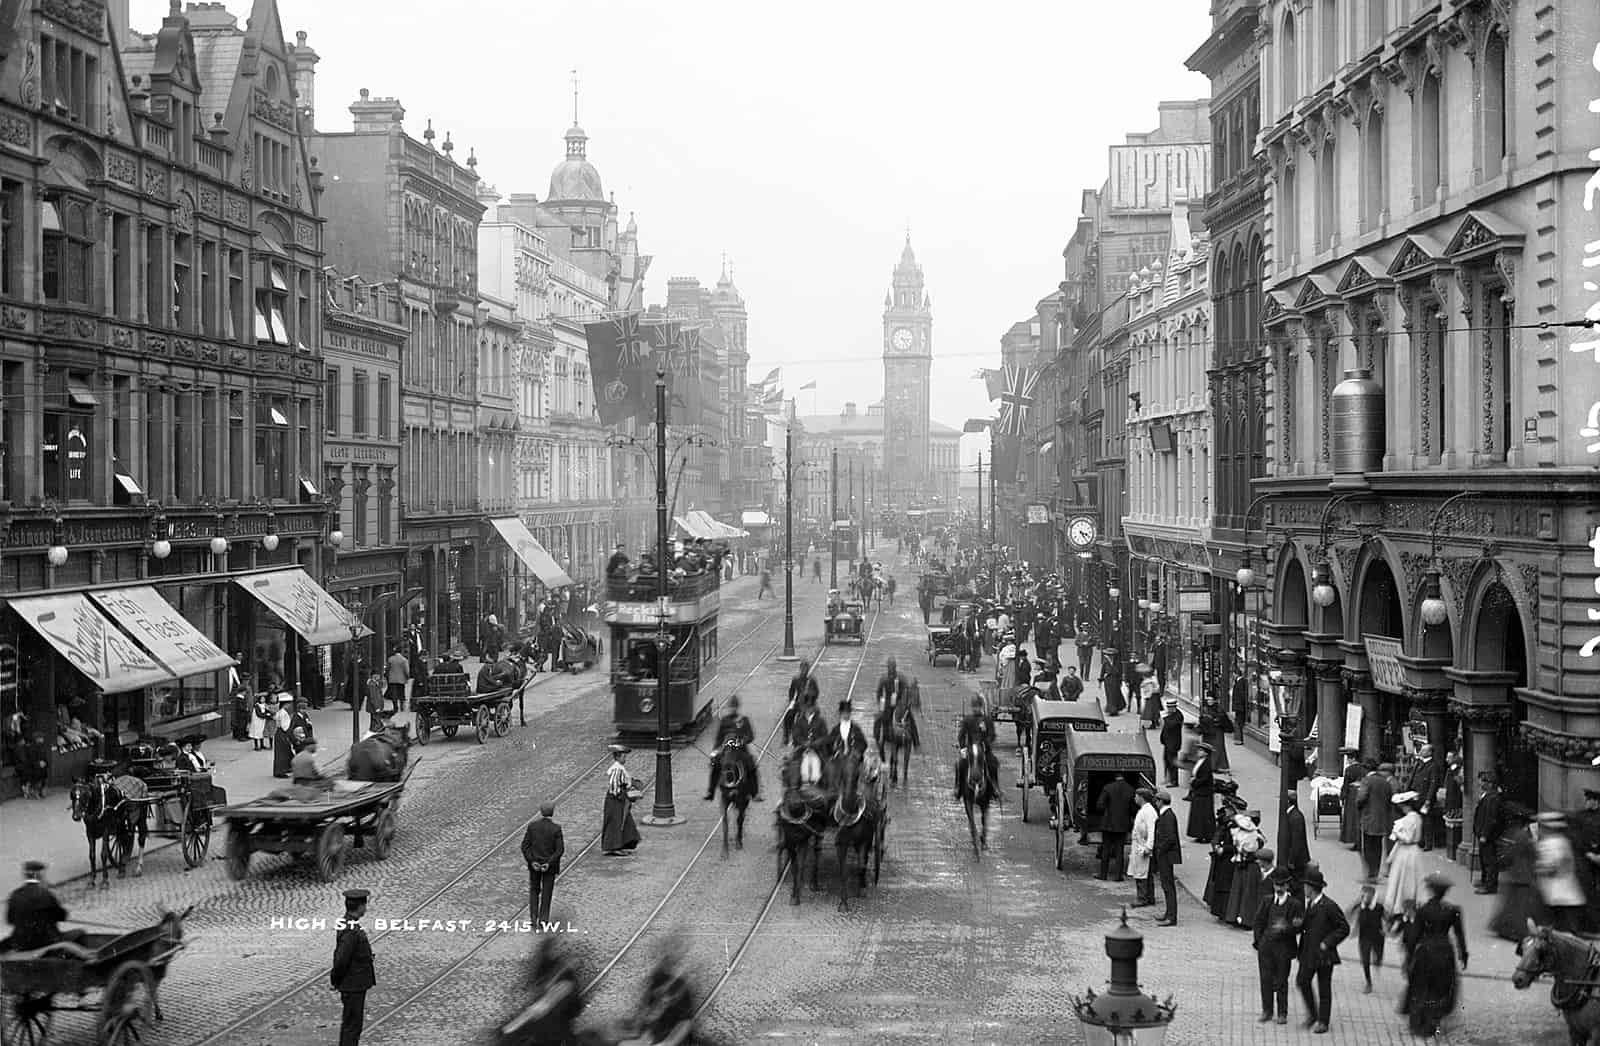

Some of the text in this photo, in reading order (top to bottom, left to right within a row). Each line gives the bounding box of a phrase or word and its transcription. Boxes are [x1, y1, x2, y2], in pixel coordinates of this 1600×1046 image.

[1111, 148, 1206, 208] LIPTON
[98, 592, 145, 617] Fish
[136, 615, 190, 641] Flesh
